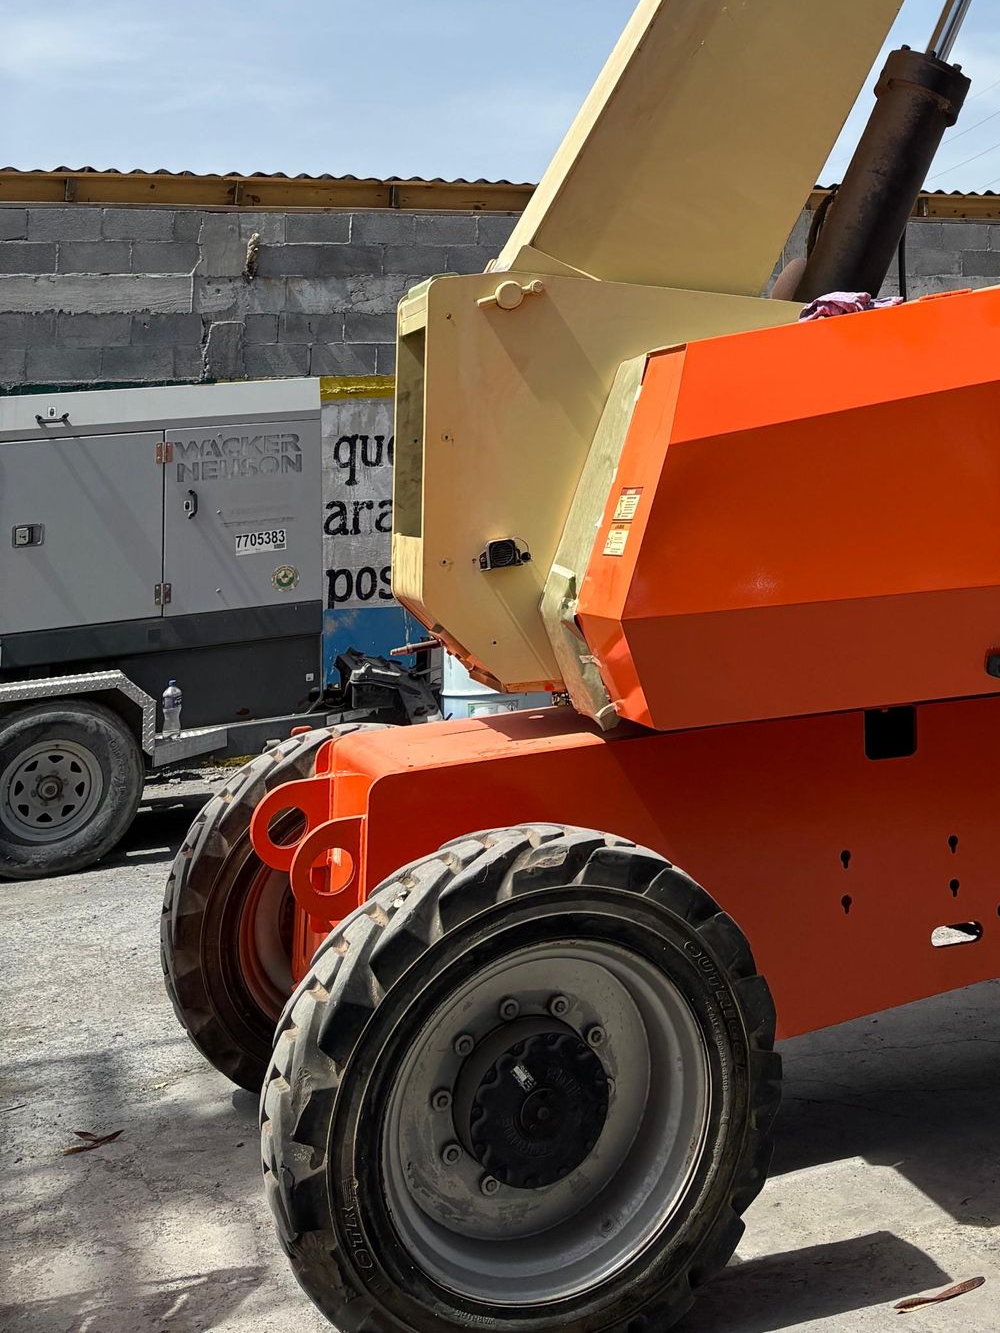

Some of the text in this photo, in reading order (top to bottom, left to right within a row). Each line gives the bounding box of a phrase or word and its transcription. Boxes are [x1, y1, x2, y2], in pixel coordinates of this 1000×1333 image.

[174, 433, 302, 458] WACKER
[176, 454, 302, 483] NEUSON
[235, 530, 285, 548] 7705383
